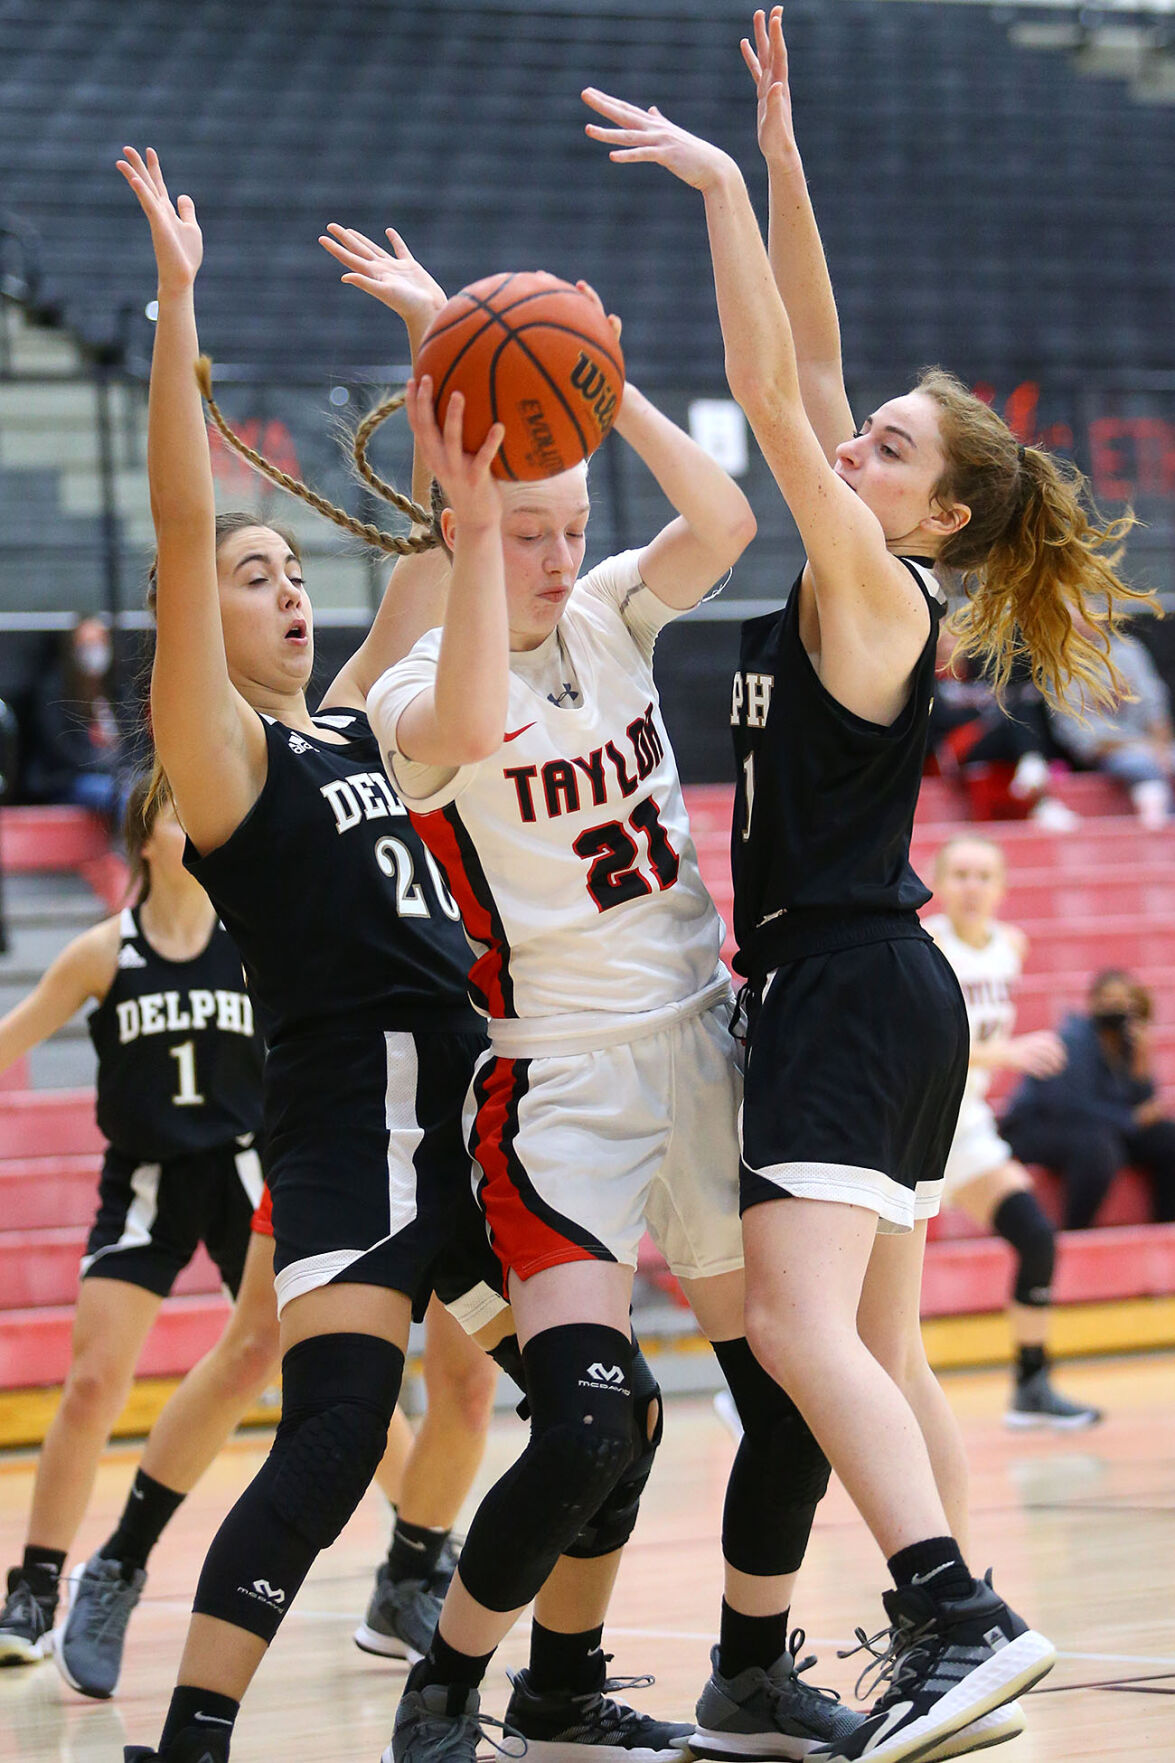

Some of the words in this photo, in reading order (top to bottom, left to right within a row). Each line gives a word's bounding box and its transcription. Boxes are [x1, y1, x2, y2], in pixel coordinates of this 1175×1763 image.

[572, 795, 680, 914] 21
[116, 989, 254, 1045] DELPHI
[170, 1039, 205, 1106] 1
